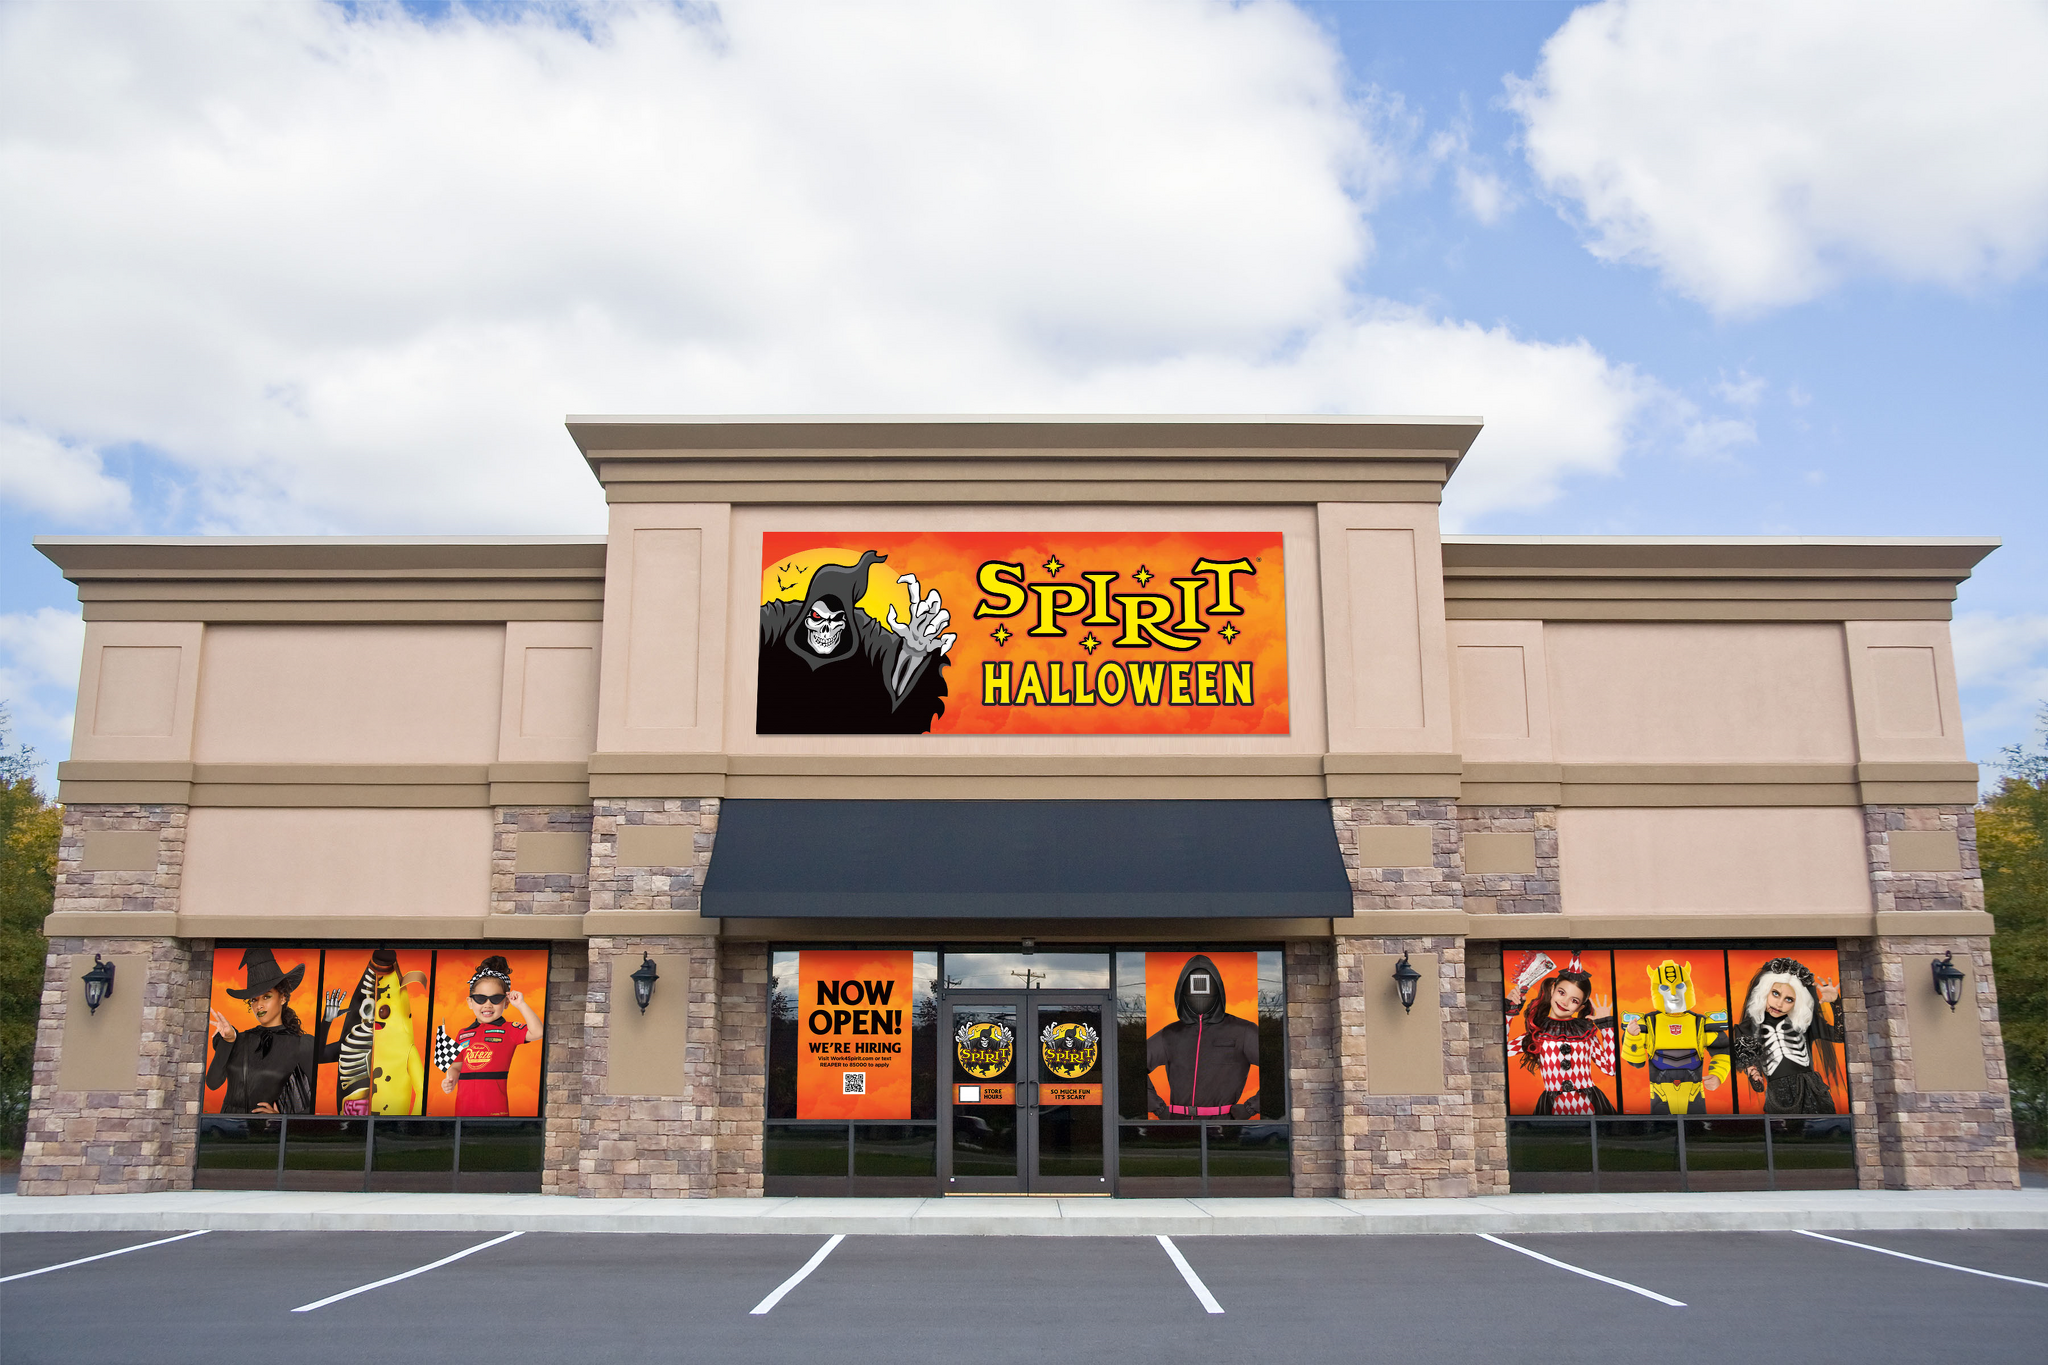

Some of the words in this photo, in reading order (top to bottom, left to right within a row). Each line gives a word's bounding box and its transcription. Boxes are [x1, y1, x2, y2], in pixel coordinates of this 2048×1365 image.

[974, 557, 1256, 651] SPIRIT
[982, 661, 1254, 706] HALLOWEEN
[816, 980, 895, 1006] NOW
[808, 1009, 902, 1035] OPEN!
[808, 1042, 851, 1053] WE'RE
[855, 1042, 902, 1053] HIRING
[962, 1048, 1009, 1063] SPIRIT
[1047, 1048, 1094, 1063] SPIRIT
